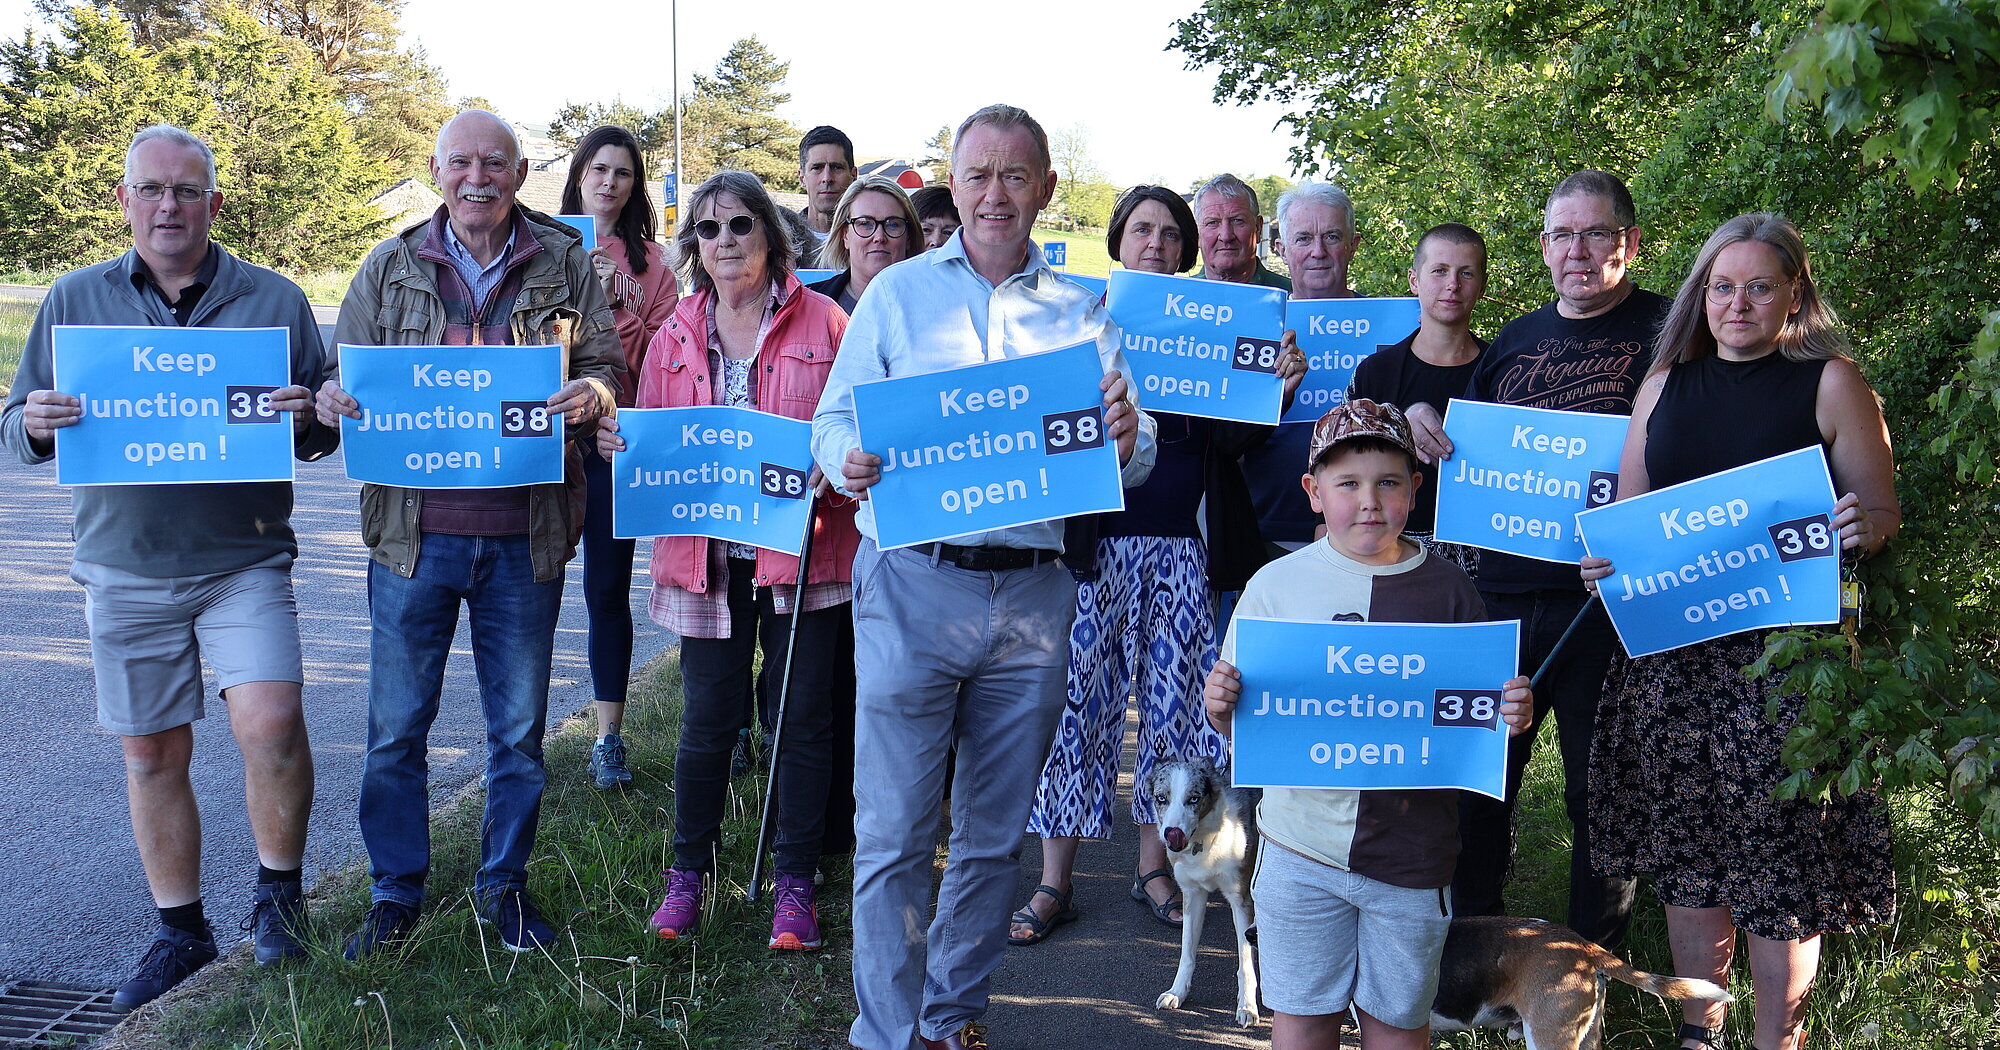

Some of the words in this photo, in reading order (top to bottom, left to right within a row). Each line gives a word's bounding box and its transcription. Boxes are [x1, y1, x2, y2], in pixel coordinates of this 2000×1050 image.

[1164, 293, 1233, 326] Keep
[1309, 315, 1370, 338] Keep
[133, 346, 216, 377] Keep
[1236, 343, 1276, 368] 38
[413, 364, 492, 392] Keep
[1144, 374, 1210, 398] open
[1220, 377, 1229, 400] !
[1496, 352, 1631, 403] Arguing
[1558, 381, 1625, 404] EXPLAINING
[79, 392, 220, 418] Junction
[229, 392, 277, 418] 38
[939, 384, 1029, 417] Keep
[357, 404, 495, 432] Junction
[505, 407, 550, 432] 38
[124, 441, 207, 467] open
[219, 434, 227, 461] !
[682, 423, 754, 451] Keep
[883, 429, 1037, 472] Junction
[1048, 416, 1099, 447] 38
[1511, 424, 1587, 460] Keep
[405, 451, 482, 474] open
[494, 446, 501, 470] !
[629, 461, 755, 488] Junction
[764, 469, 803, 495] 38
[940, 479, 1027, 515] open
[1039, 467, 1049, 496] !
[1454, 459, 1581, 500] Junction
[672, 502, 742, 522] open
[753, 502, 760, 525] !
[1491, 512, 1562, 540] open
[1659, 498, 1749, 540] Keep
[1621, 543, 1770, 601] Junction
[1777, 522, 1830, 555] 38
[1684, 586, 1771, 623] open
[1778, 574, 1792, 601] !
[1843, 590, 1851, 606] GO
[1326, 645, 1426, 680] Keep
[1253, 691, 1425, 718] Junction
[1438, 695, 1495, 721] 38
[1309, 742, 1405, 770] open
[1421, 737, 1430, 766] !
